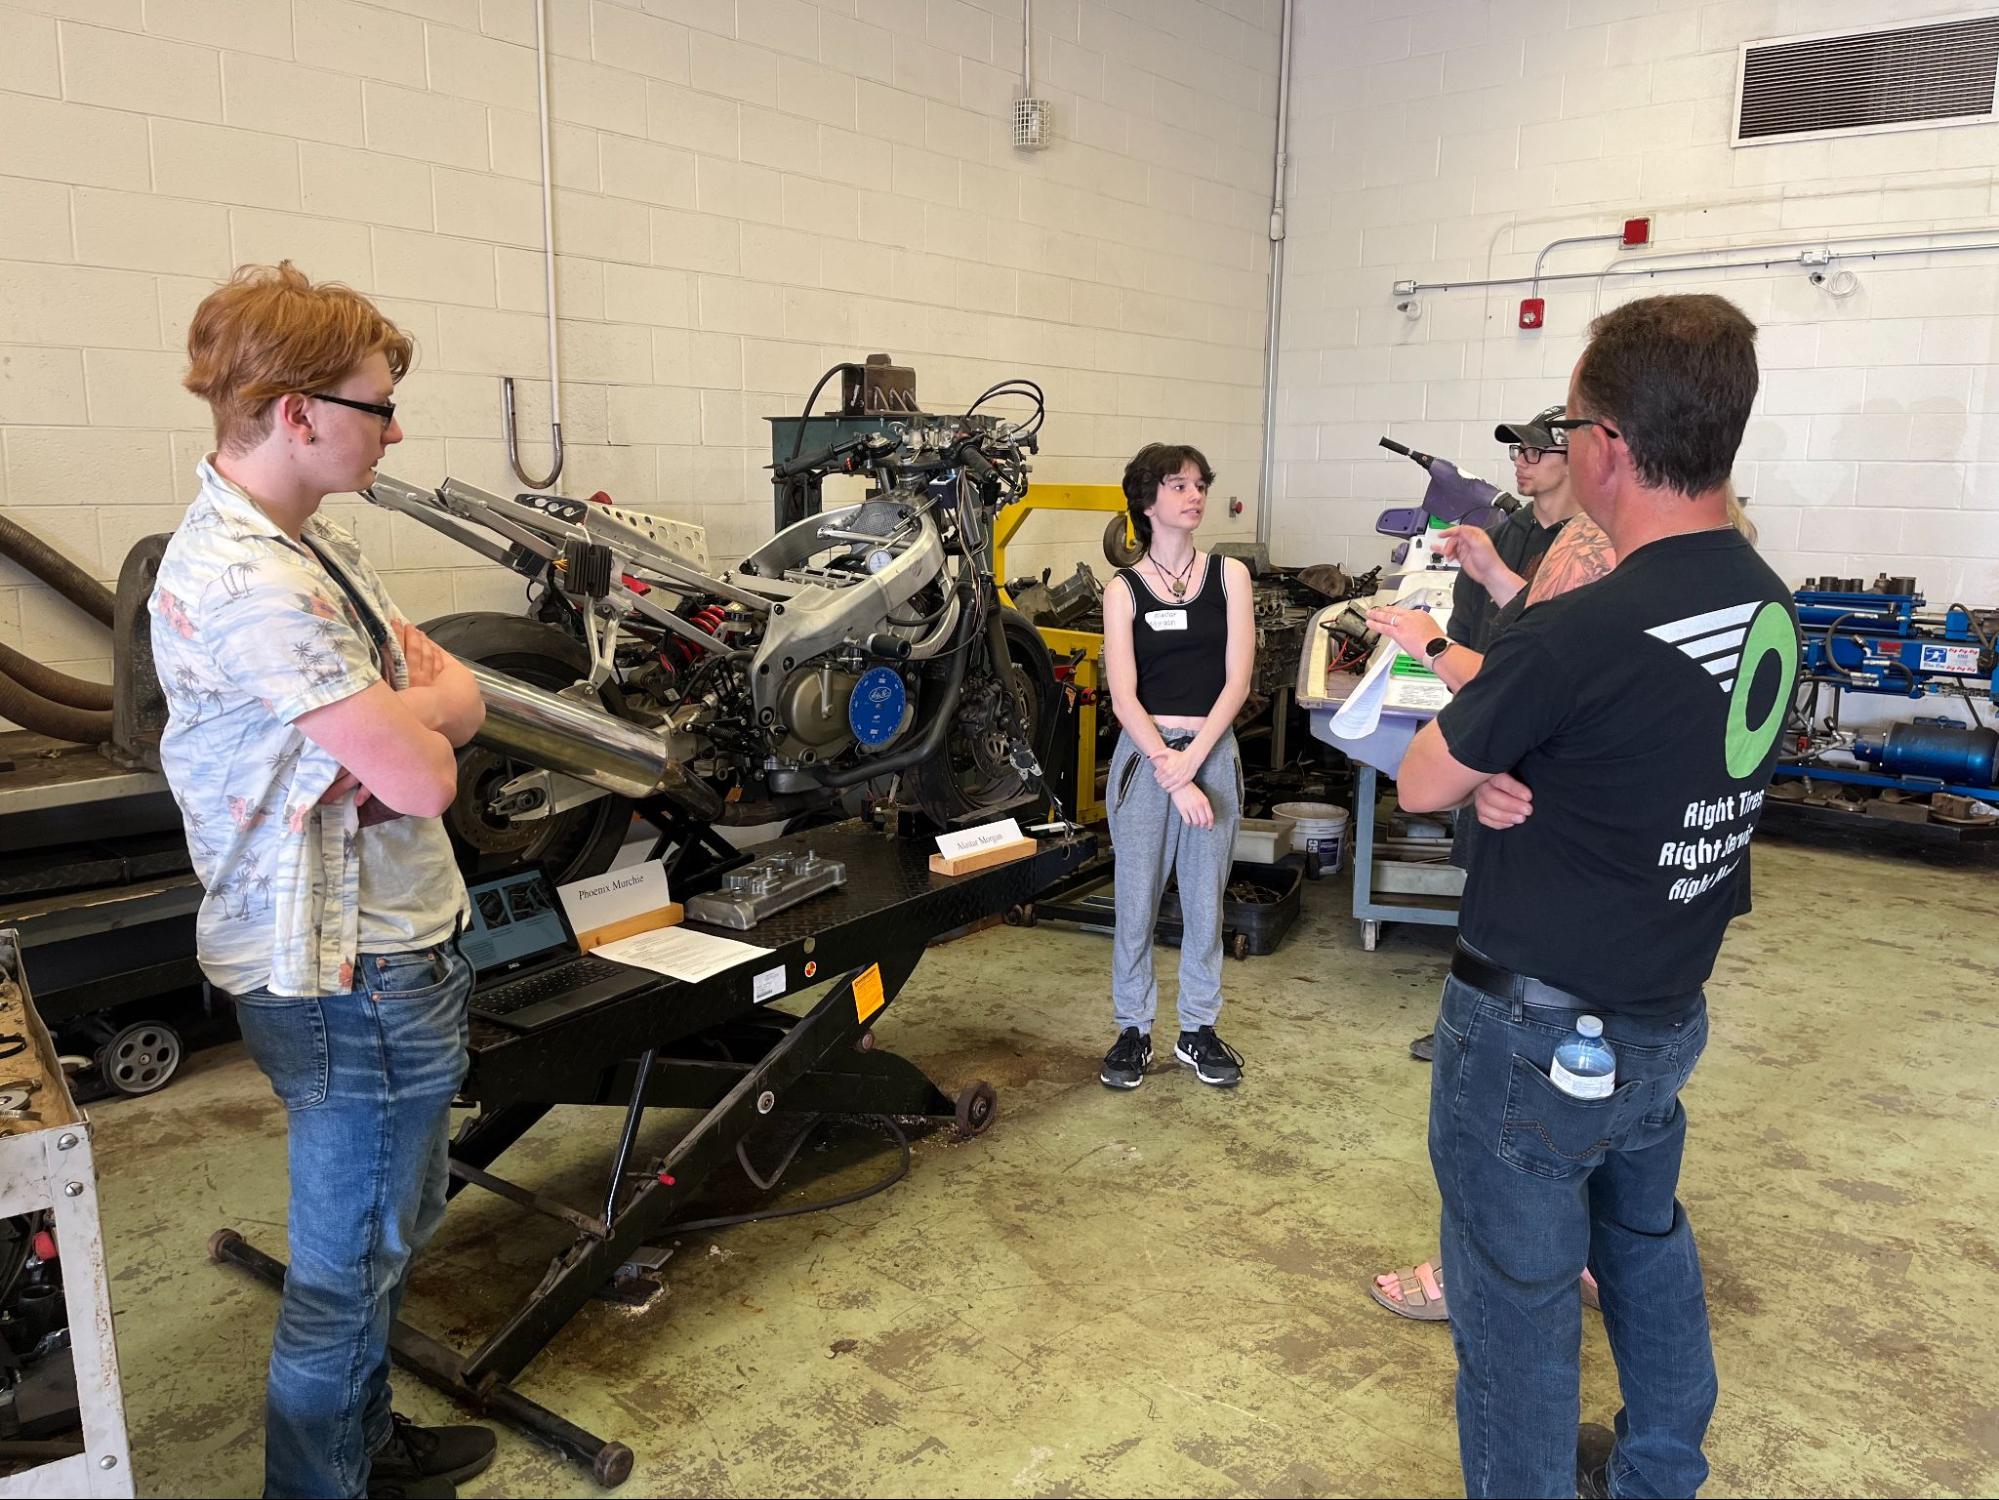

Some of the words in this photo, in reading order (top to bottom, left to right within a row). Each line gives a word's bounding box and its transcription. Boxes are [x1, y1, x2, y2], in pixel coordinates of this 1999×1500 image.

[1683, 796, 1735, 830] Right
[1739, 789, 1765, 817] Tires
[1658, 837, 1722, 870] Right
[578, 884, 611, 900] Phoenix
[612, 874, 644, 891] Murchie
